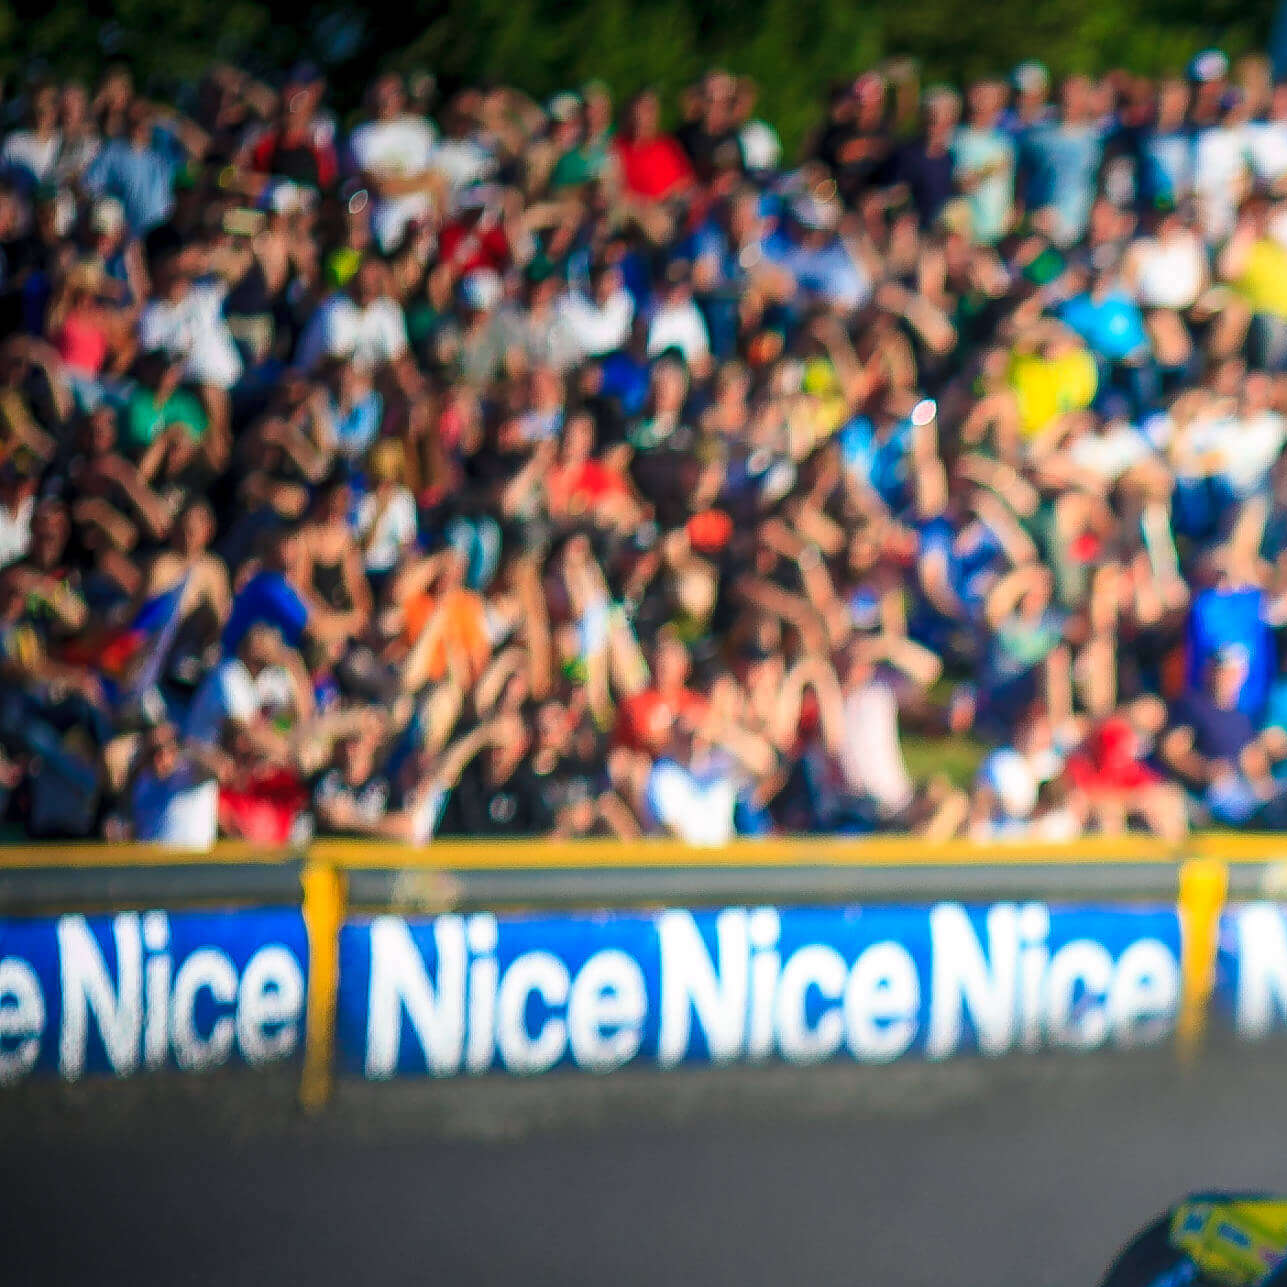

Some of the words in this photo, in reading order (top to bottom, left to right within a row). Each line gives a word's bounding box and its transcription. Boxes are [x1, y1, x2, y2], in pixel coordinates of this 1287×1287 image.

[57, 910, 304, 1082] Nice
[365, 910, 646, 1078] Nice
[655, 906, 919, 1066] Nice
[926, 902, 1181, 1060] Nice
